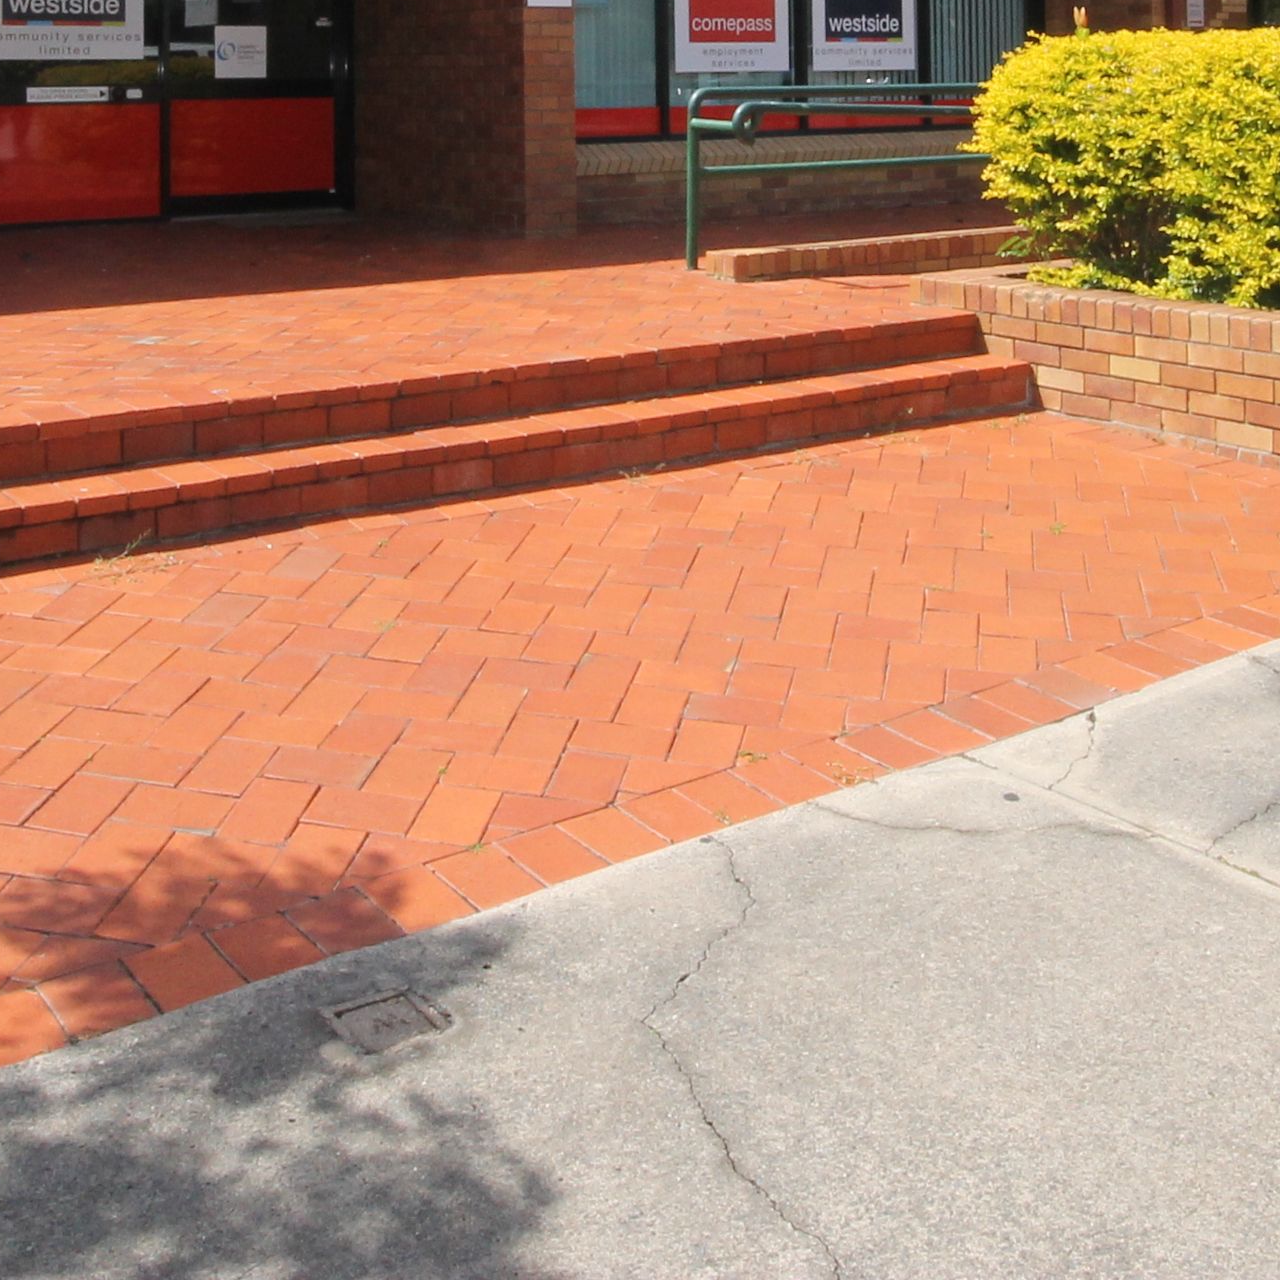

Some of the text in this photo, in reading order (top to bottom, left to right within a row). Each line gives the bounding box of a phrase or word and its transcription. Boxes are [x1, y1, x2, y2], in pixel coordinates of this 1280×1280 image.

[691, 16, 774, 36] comepass
[828, 13, 900, 33] westside
[76, 31, 142, 42] services
[38, 45, 92, 56] limited
[701, 46, 765, 58] employment
[814, 46, 913, 58] community services
[710, 58, 757, 69] services
[847, 57, 883, 68] limited
